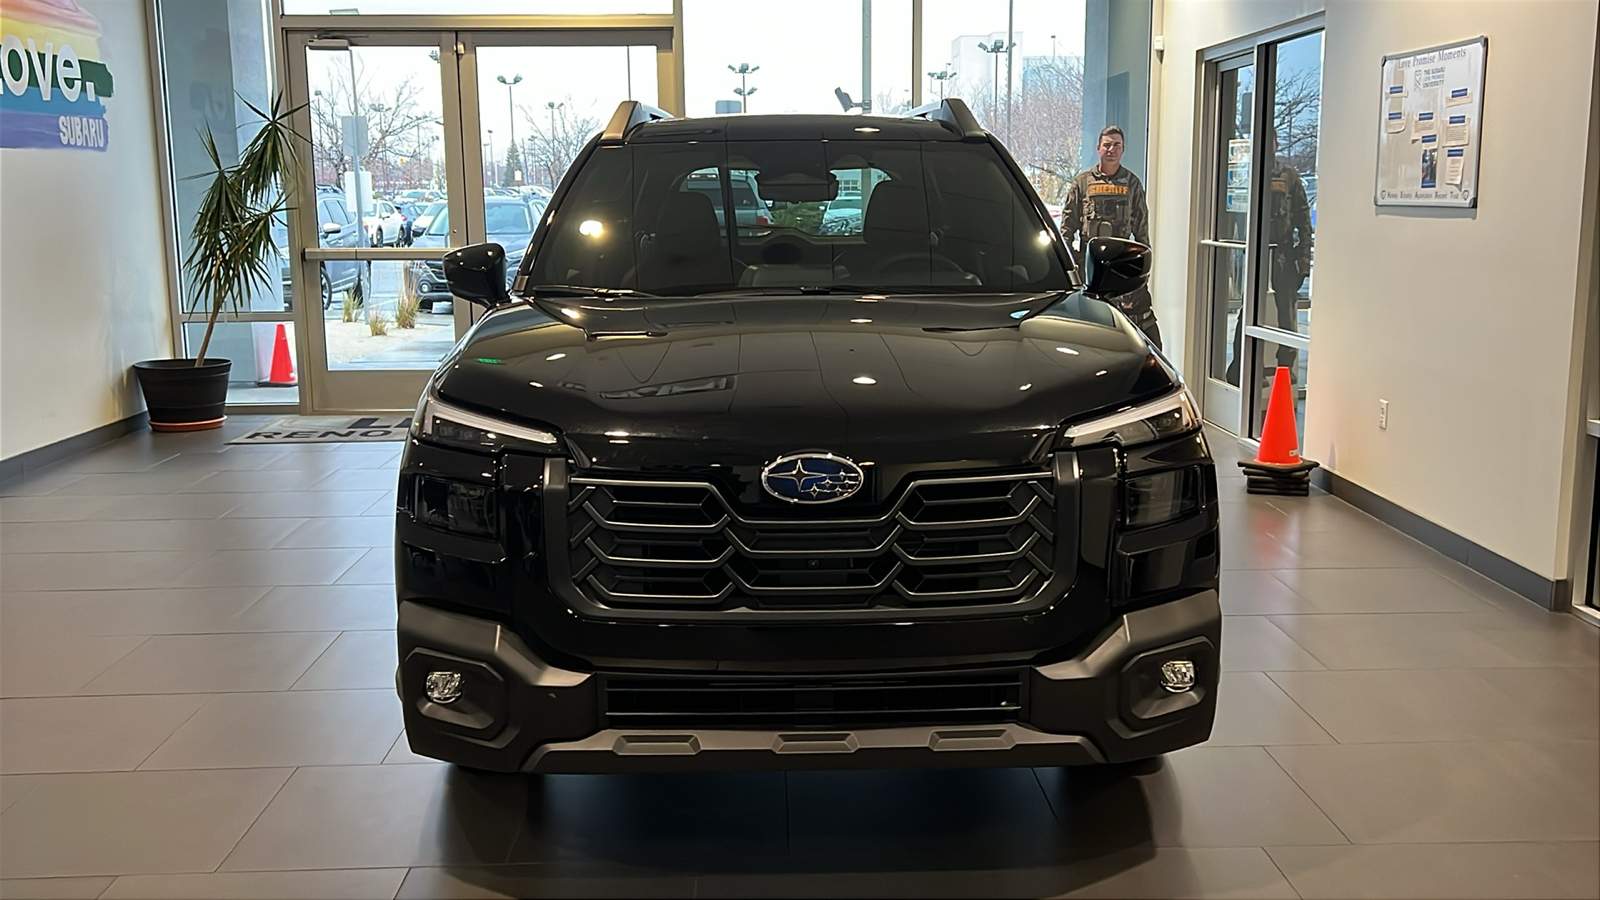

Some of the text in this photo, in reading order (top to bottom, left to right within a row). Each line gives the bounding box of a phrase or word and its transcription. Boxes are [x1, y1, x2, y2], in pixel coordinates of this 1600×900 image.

[0, 34, 95, 102] ove.
[1397, 48, 1466, 69] Love Promise Moments
[58, 115, 105, 148] SUBARU
[1088, 185, 1129, 194] SHERIFF
[245, 430, 392, 439] RENO
